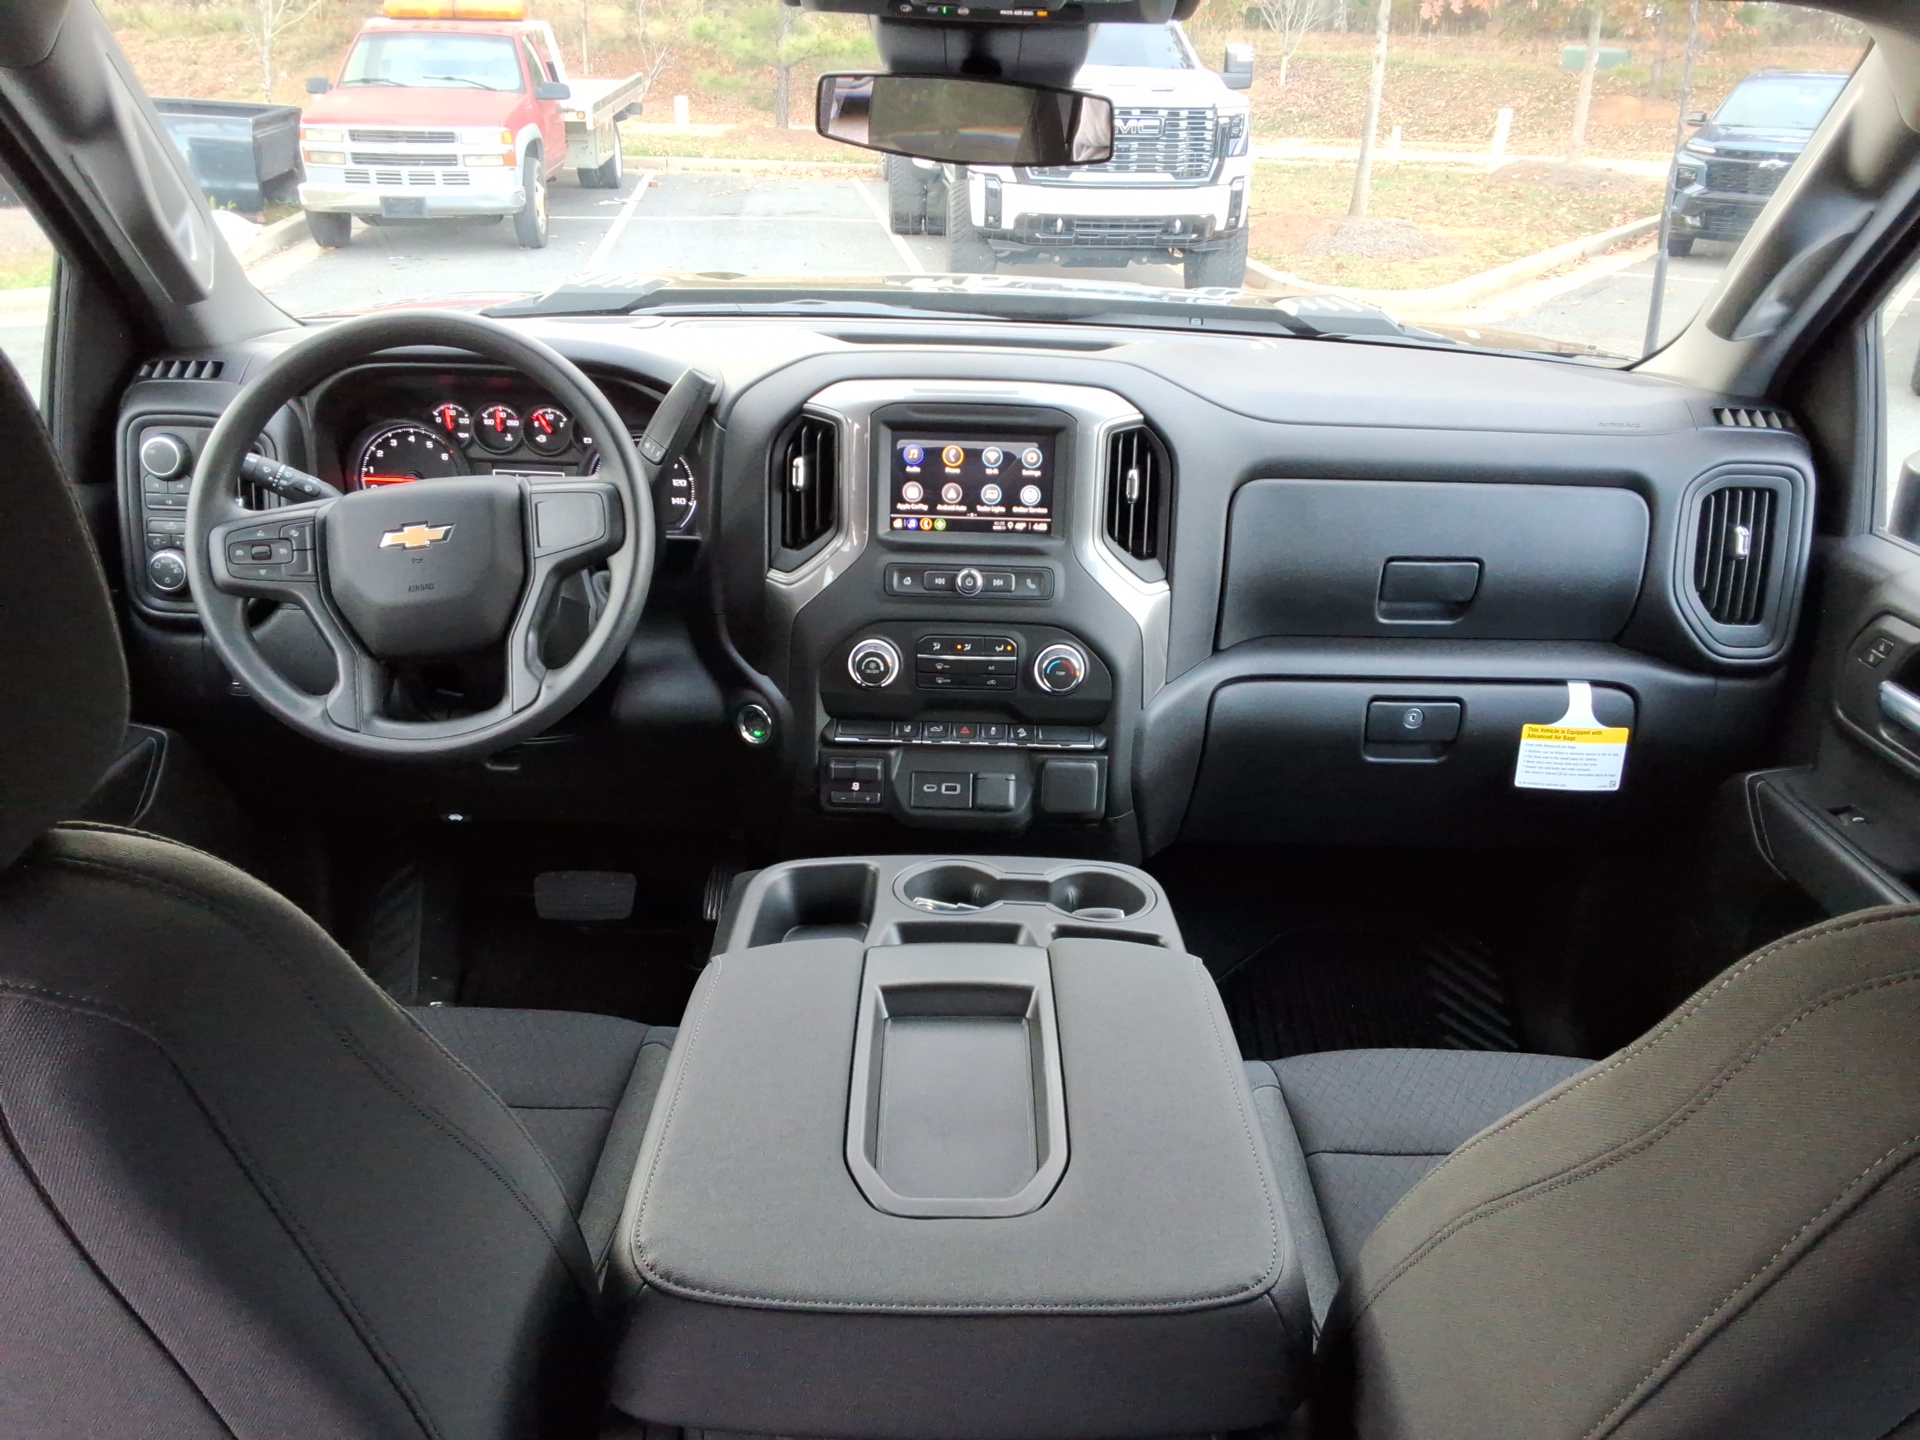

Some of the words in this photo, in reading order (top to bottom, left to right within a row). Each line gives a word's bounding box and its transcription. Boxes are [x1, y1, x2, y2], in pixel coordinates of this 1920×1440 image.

[1114, 118, 1161, 134] MC
[390, 439, 398, 447] 3
[408, 435, 416, 443] 4
[426, 441, 434, 449] 5
[369, 466, 374, 474] 1
[672, 479, 688, 487] 120
[671, 497, 687, 505] 140
[408, 583, 435, 593] AIRBAG
